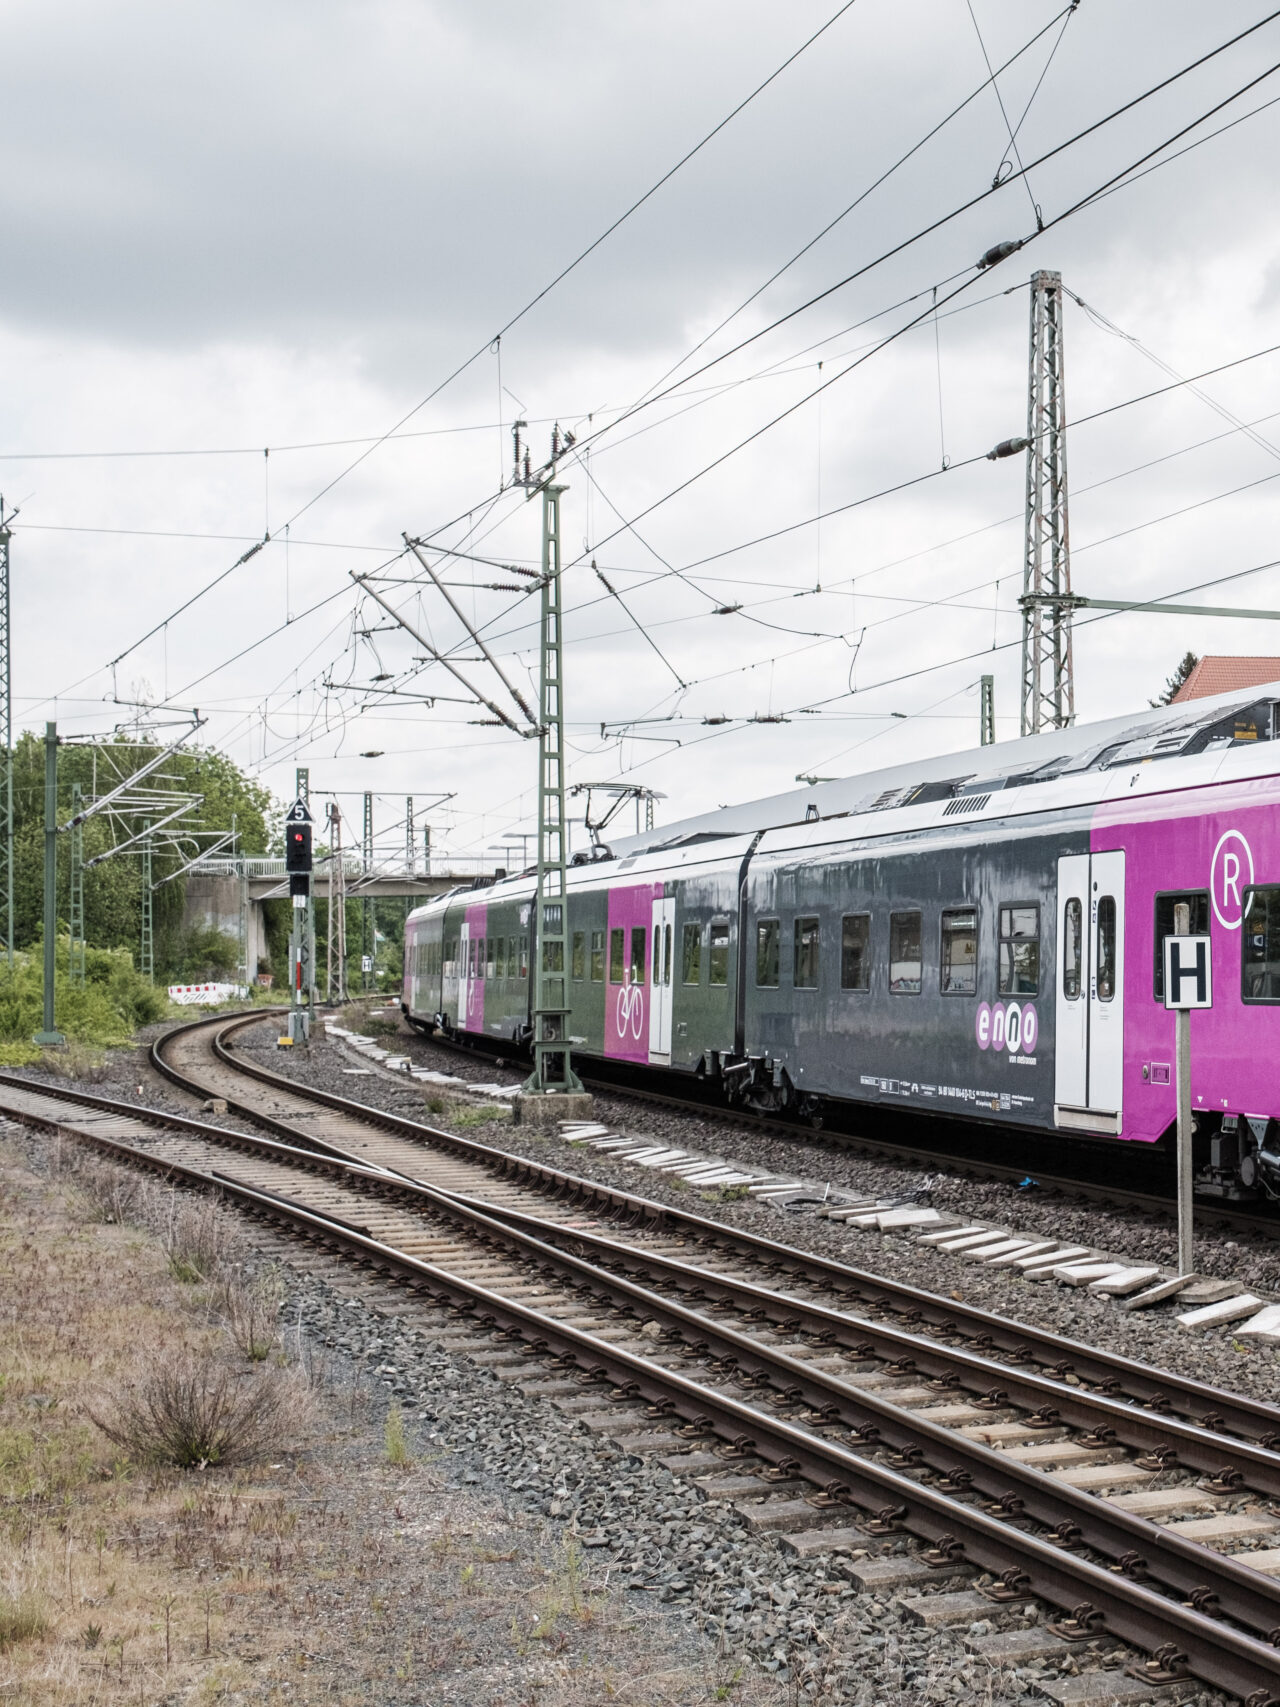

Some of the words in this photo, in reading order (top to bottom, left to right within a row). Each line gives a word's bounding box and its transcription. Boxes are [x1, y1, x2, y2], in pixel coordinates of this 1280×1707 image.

[294, 804, 305, 820] 5
[1223, 853, 1241, 907] R
[1170, 941, 1207, 1003] H
[977, 1004, 1036, 1049] enno
